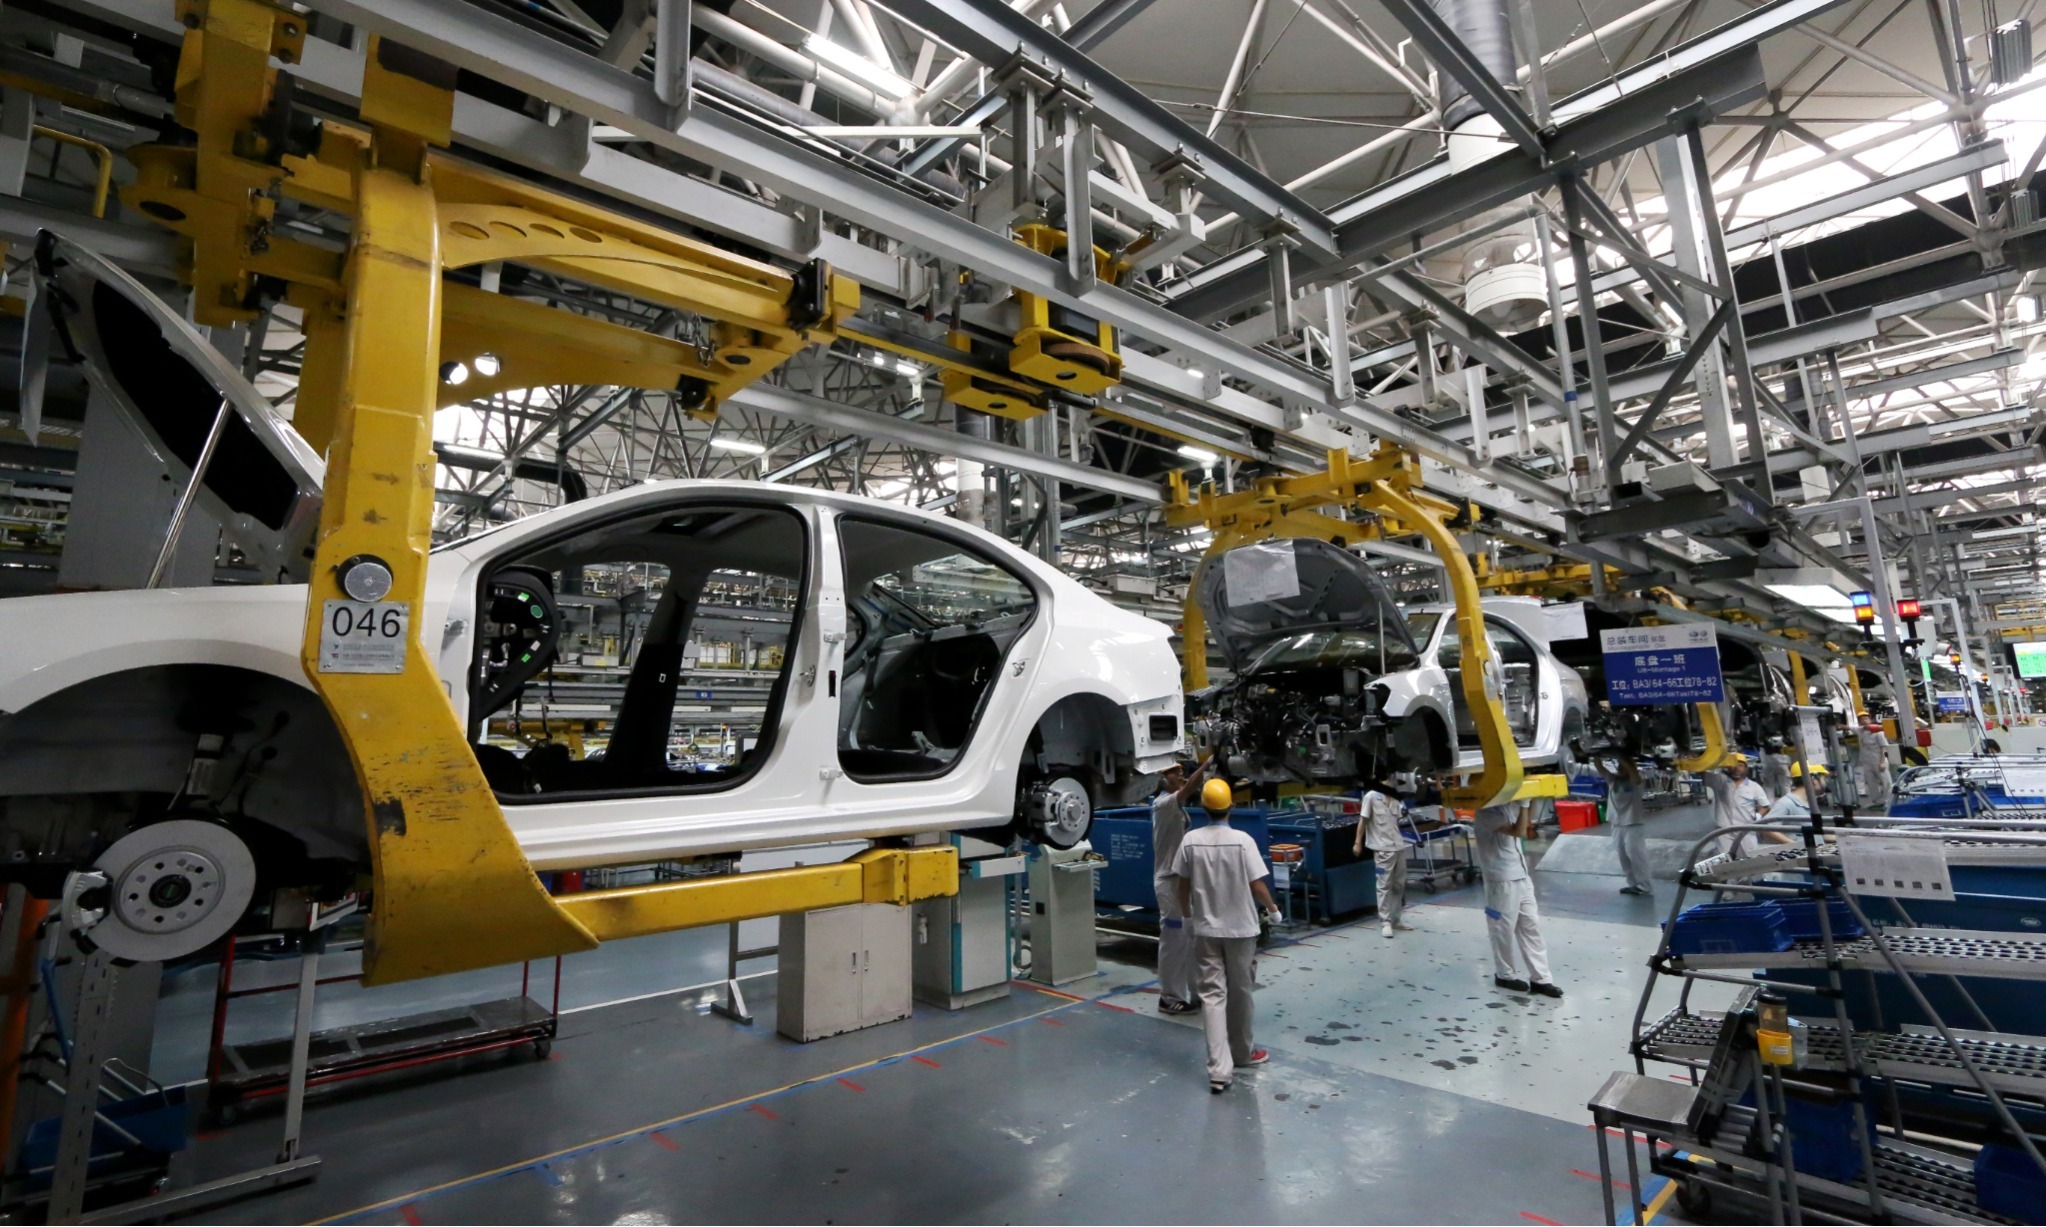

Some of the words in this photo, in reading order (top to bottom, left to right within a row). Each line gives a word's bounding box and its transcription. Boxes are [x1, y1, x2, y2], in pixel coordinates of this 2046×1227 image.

[332, 606, 401, 638] 046
[1607, 634, 1649, 646] 总装车间
[1634, 654, 1686, 667] 底盘一班
